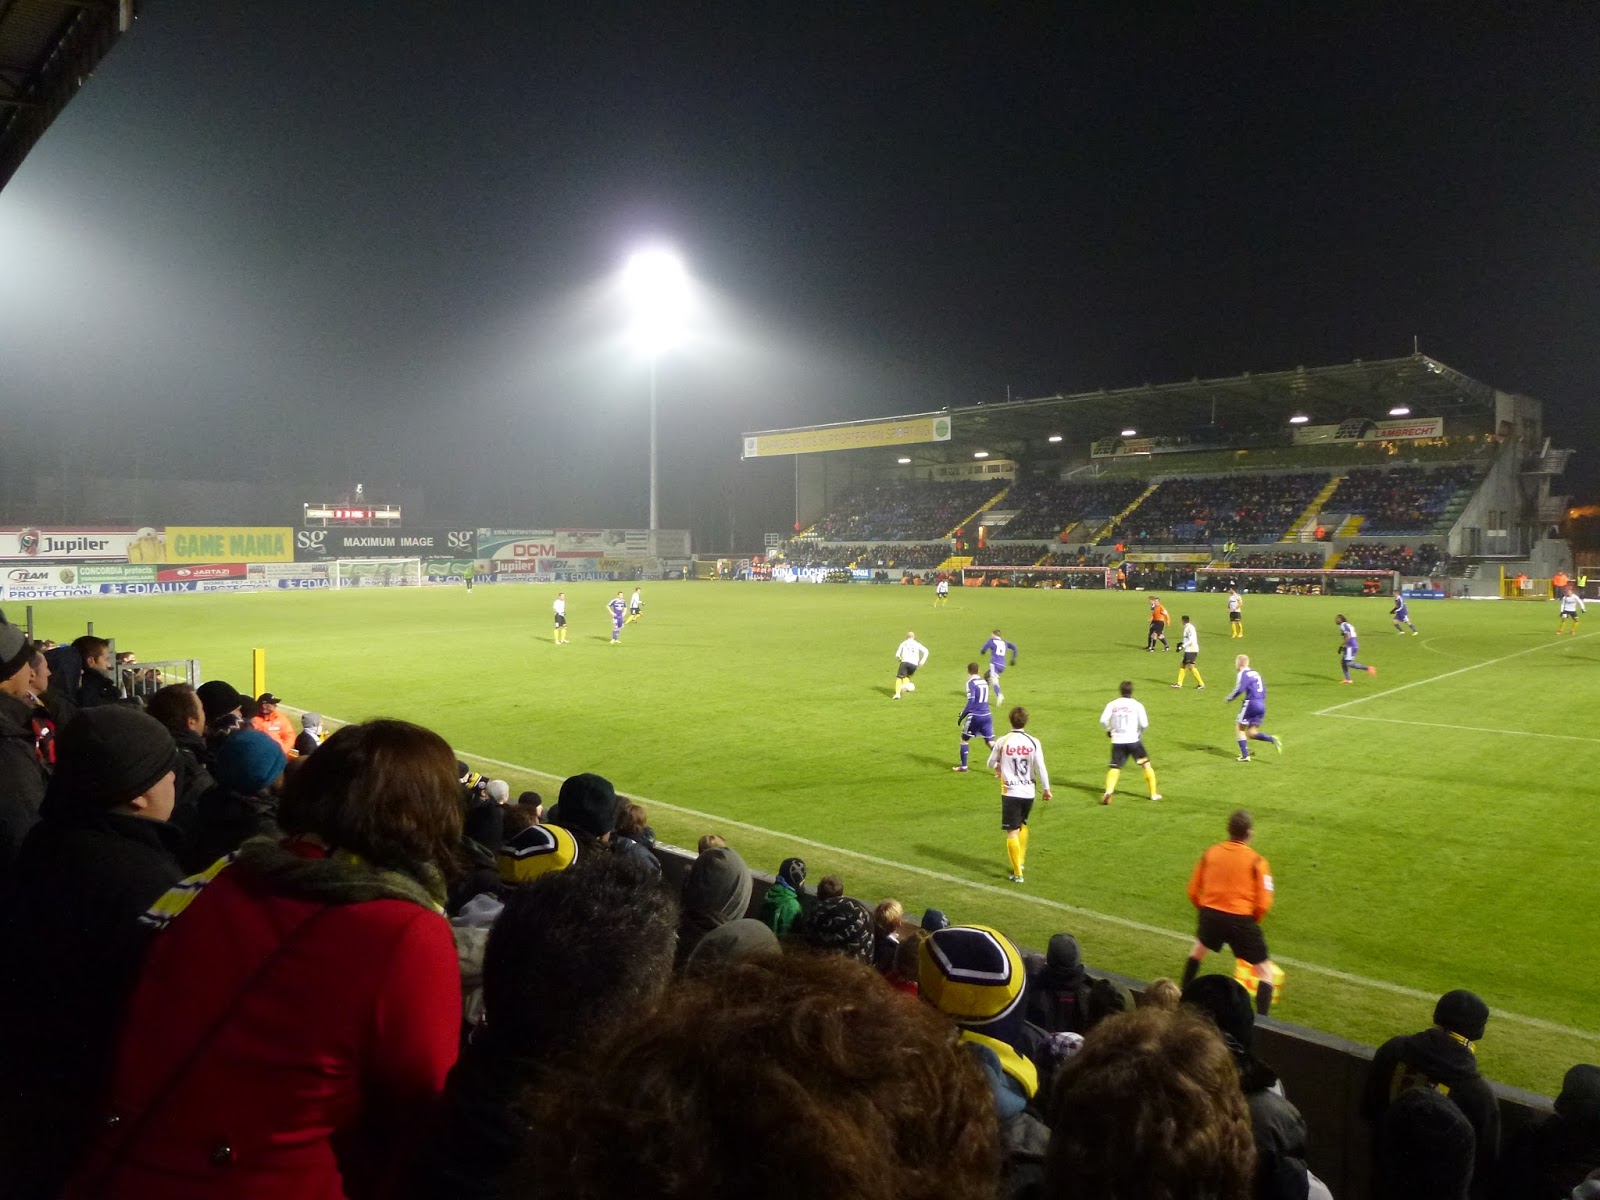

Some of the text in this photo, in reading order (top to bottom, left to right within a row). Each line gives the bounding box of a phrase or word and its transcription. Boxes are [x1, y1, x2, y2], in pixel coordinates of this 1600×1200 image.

[1374, 427, 1436, 438] LAMBRECHT
[42, 537, 109, 554] Jupiler
[175, 533, 285, 558] GAME MANIA
[343, 537, 434, 547] MAXIMUM IMAGE
[513, 544, 555, 557] DCM
[80, 567, 123, 575] CONCORDIA
[494, 561, 534, 573] Jupiler
[570, 573, 610, 581] EDIALUX
[9, 590, 93, 598] PROTECTION
[125, 582, 190, 594] EDIALUX
[1254, 675, 1263, 692] 3
[978, 684, 989, 703] 11
[1005, 744, 1033, 756] Lotto
[1012, 758, 1028, 776] 13
